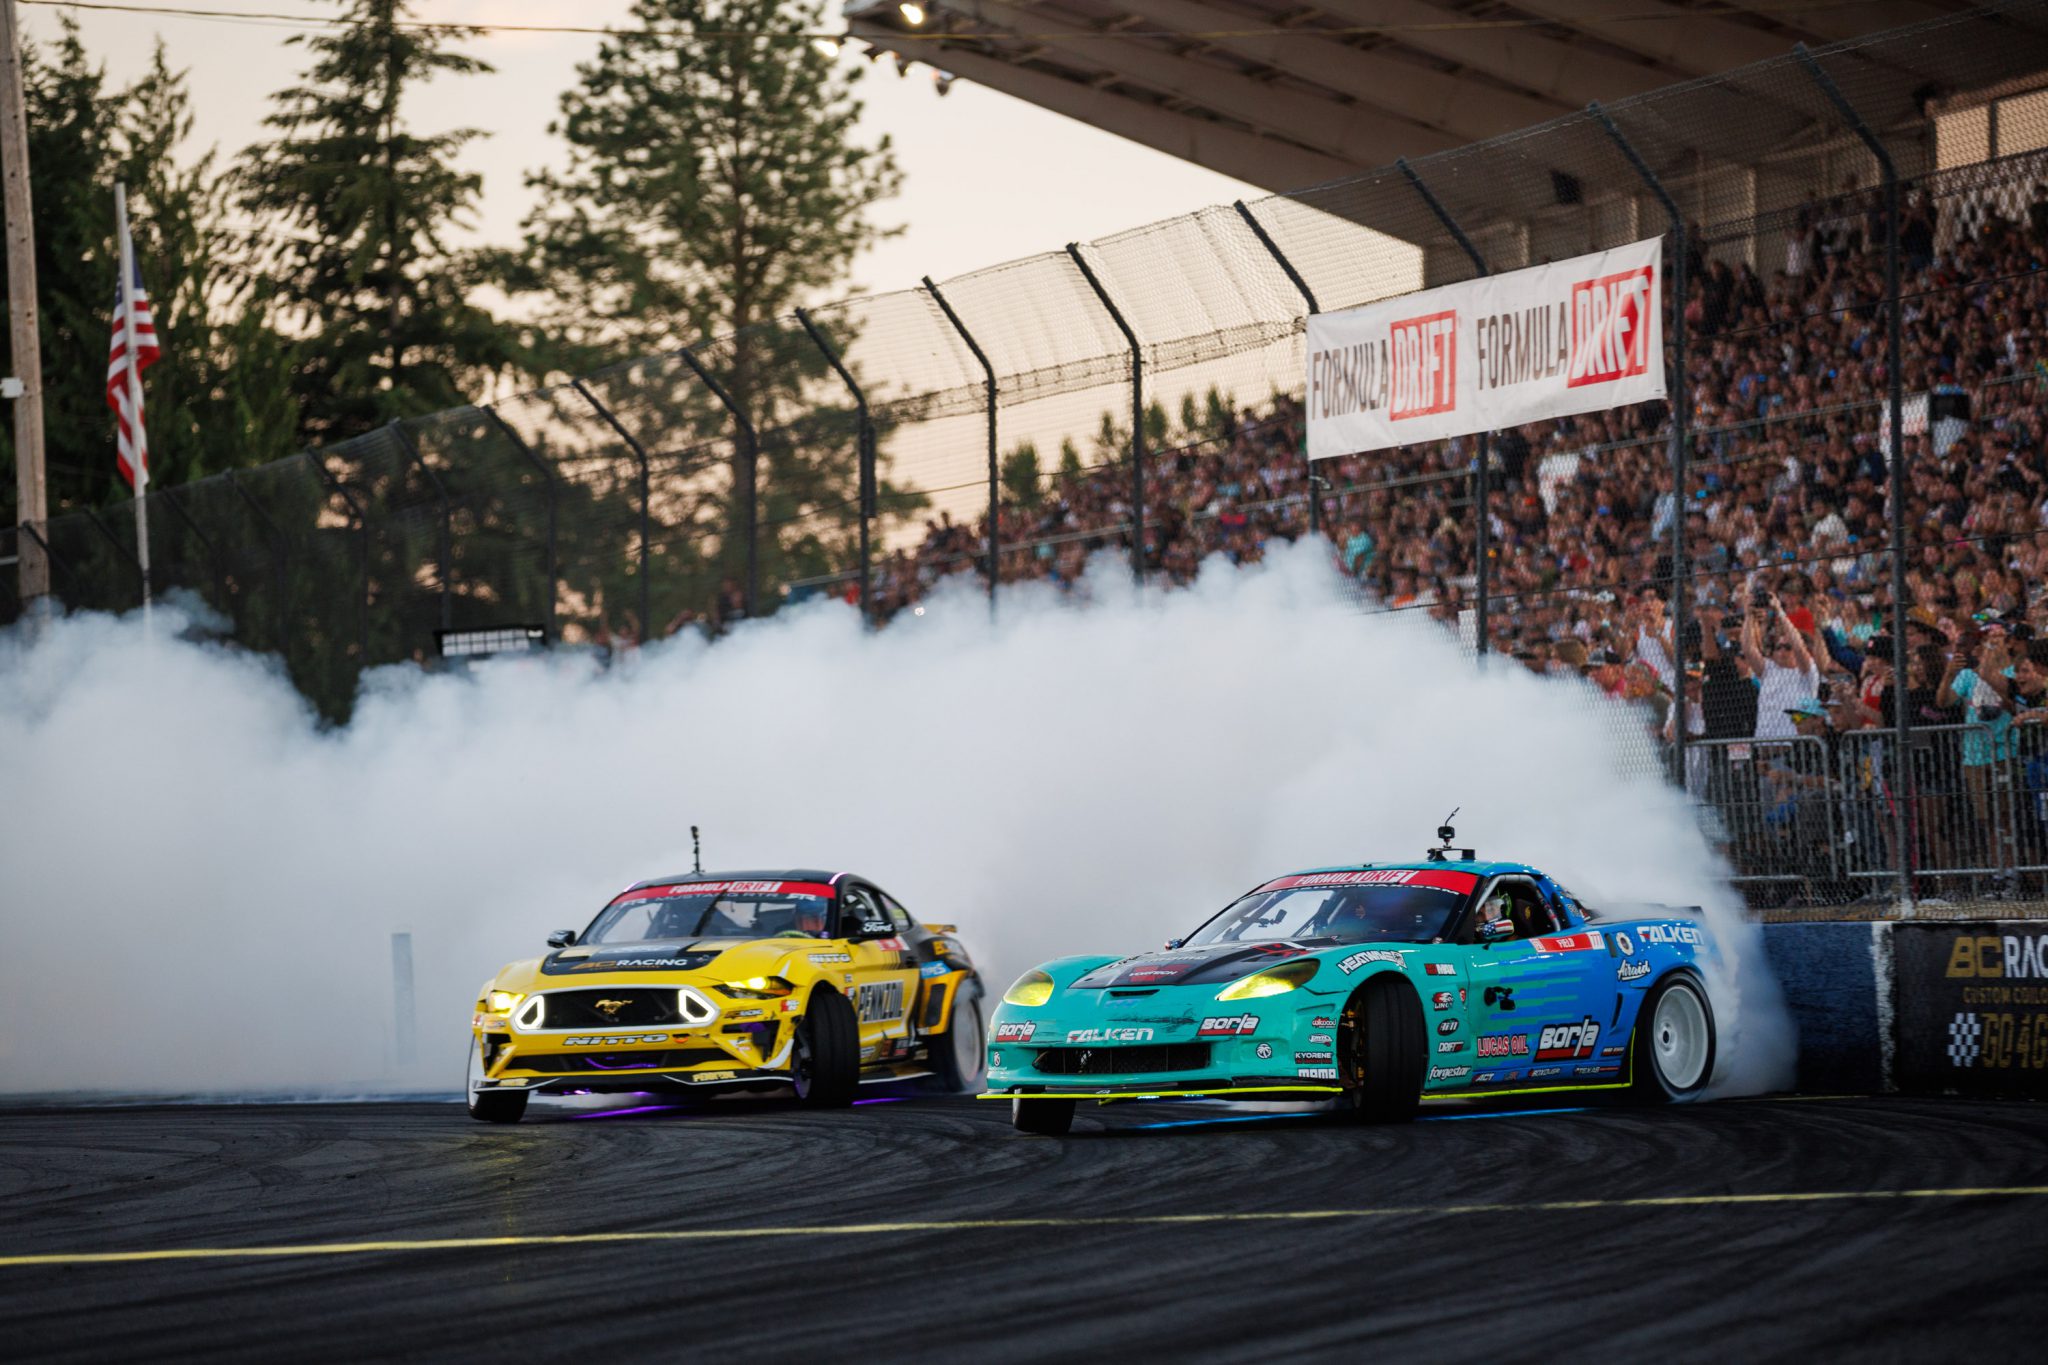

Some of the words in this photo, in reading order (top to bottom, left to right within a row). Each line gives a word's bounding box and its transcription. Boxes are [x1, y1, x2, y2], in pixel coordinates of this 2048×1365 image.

[1477, 302, 1568, 391] FORMULA
[1569, 273, 1651, 381] DRIFT
[1313, 339, 1390, 420] FORMULA
[1391, 318, 1455, 414] DRIFT
[862, 921, 893, 933] Ford
[1637, 926, 1704, 945] FALKEN
[616, 958, 688, 967] RACING
[563, 1034, 669, 1046] NITTO
[1066, 1028, 1154, 1043] FALKEN
[1477, 1037, 1510, 1057] LUCAS
[1511, 1035, 1529, 1054] OIL
